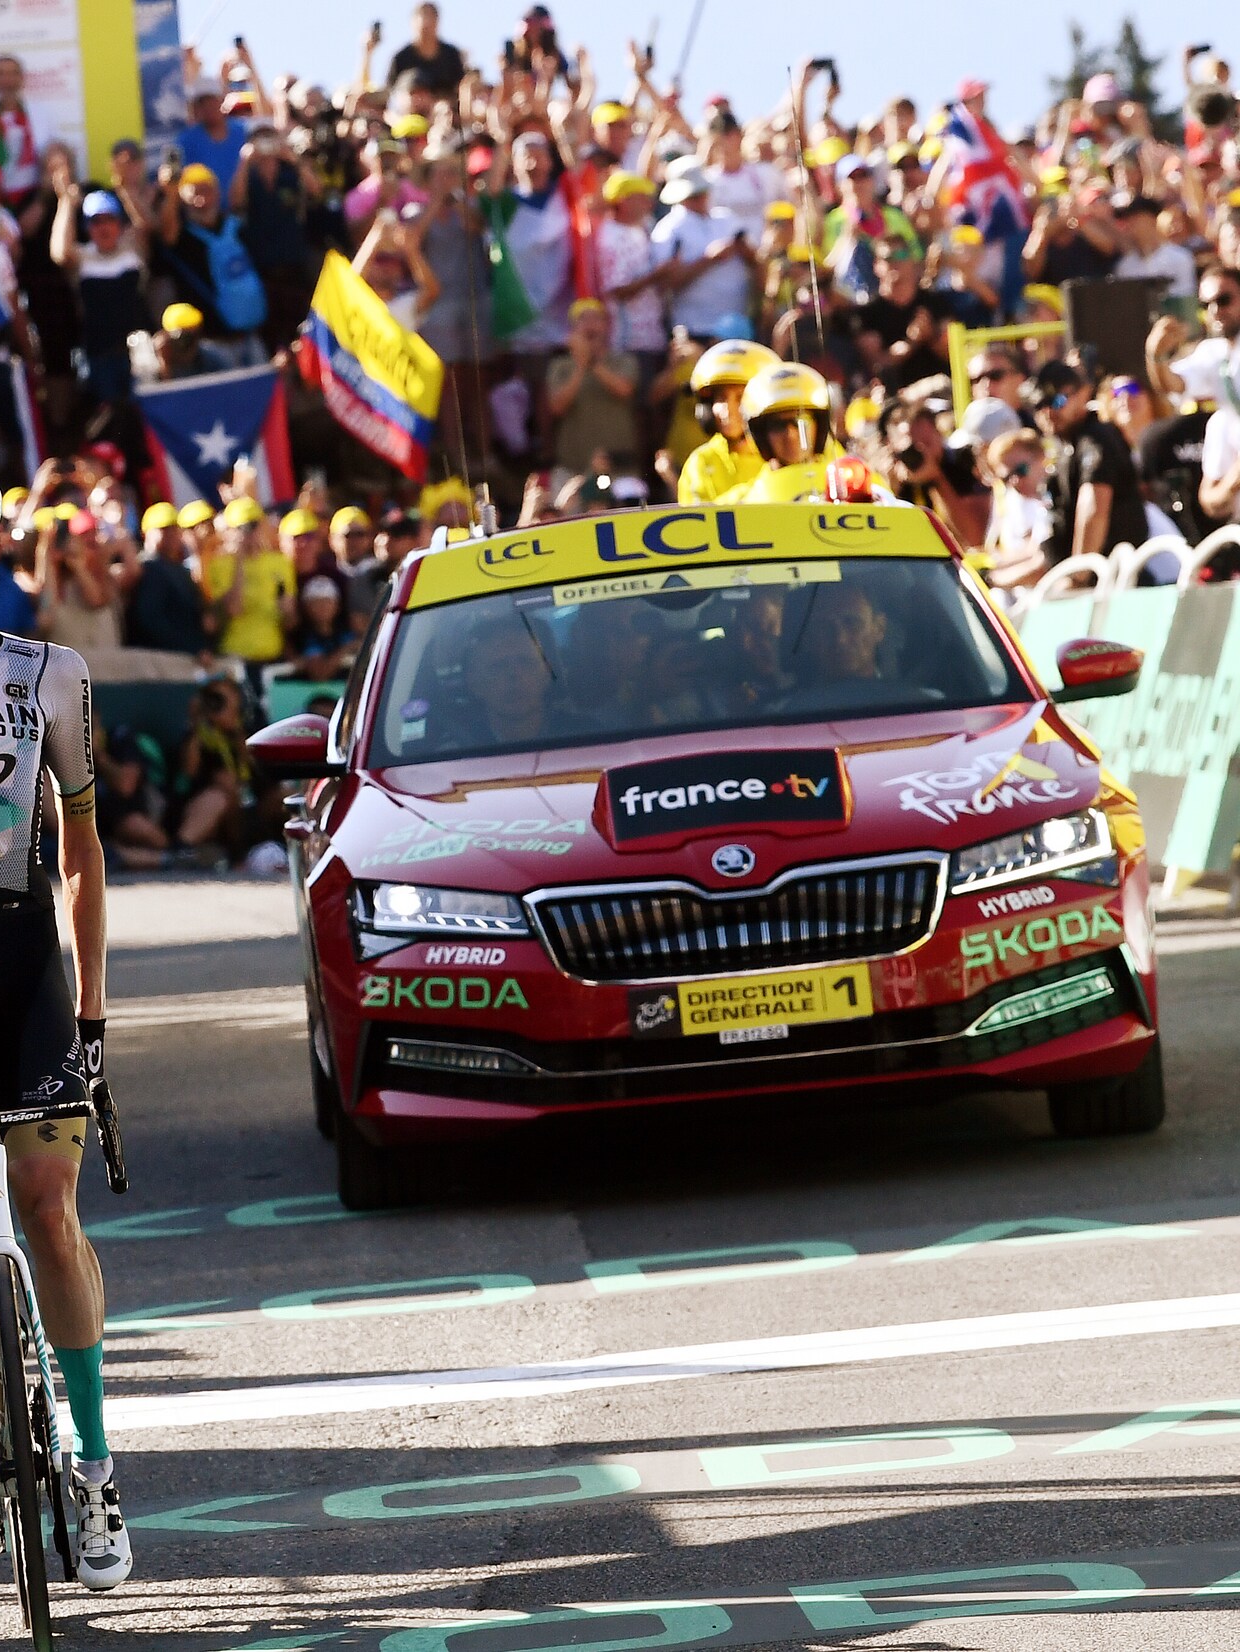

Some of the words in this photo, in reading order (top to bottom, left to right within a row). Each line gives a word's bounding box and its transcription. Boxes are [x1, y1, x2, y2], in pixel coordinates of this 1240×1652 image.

[817, 513, 890, 532] LCL
[595, 511, 774, 563] LCL
[483, 539, 555, 564] LCL
[562, 579, 654, 600] OFFICIEL
[81, 679, 94, 775] MERIDA
[977, 885, 1056, 919] HYBRID
[425, 946, 507, 966] HYBRID
[688, 979, 814, 1006] DIRECTION
[832, 976, 859, 1007] 1
[0, 1112, 44, 1123] Vision
